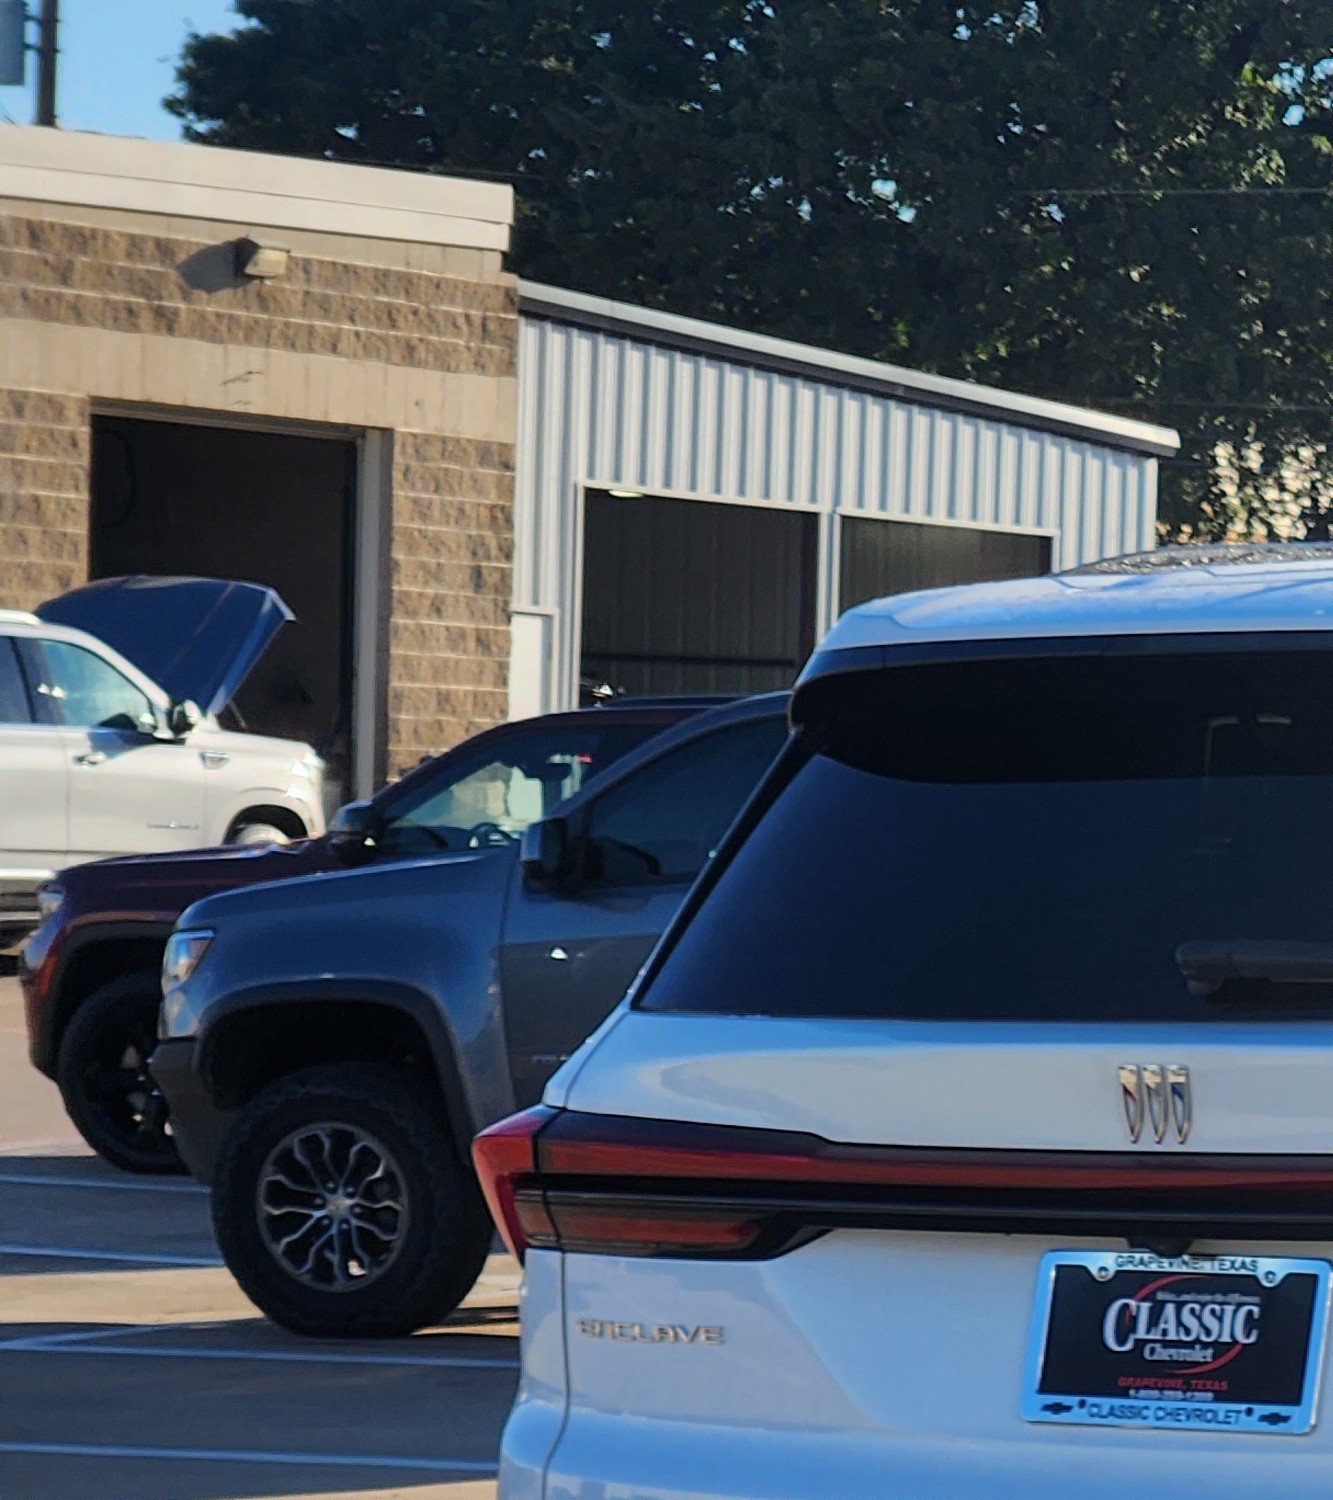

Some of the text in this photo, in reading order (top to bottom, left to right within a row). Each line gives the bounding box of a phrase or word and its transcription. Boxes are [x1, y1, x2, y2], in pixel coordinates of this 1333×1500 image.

[1103, 1298, 1261, 1352] CLASSIC
[1190, 1379, 1229, 1392] TEXAS
[1087, 1402, 1243, 1426] CLASSIC CHEVROLET
